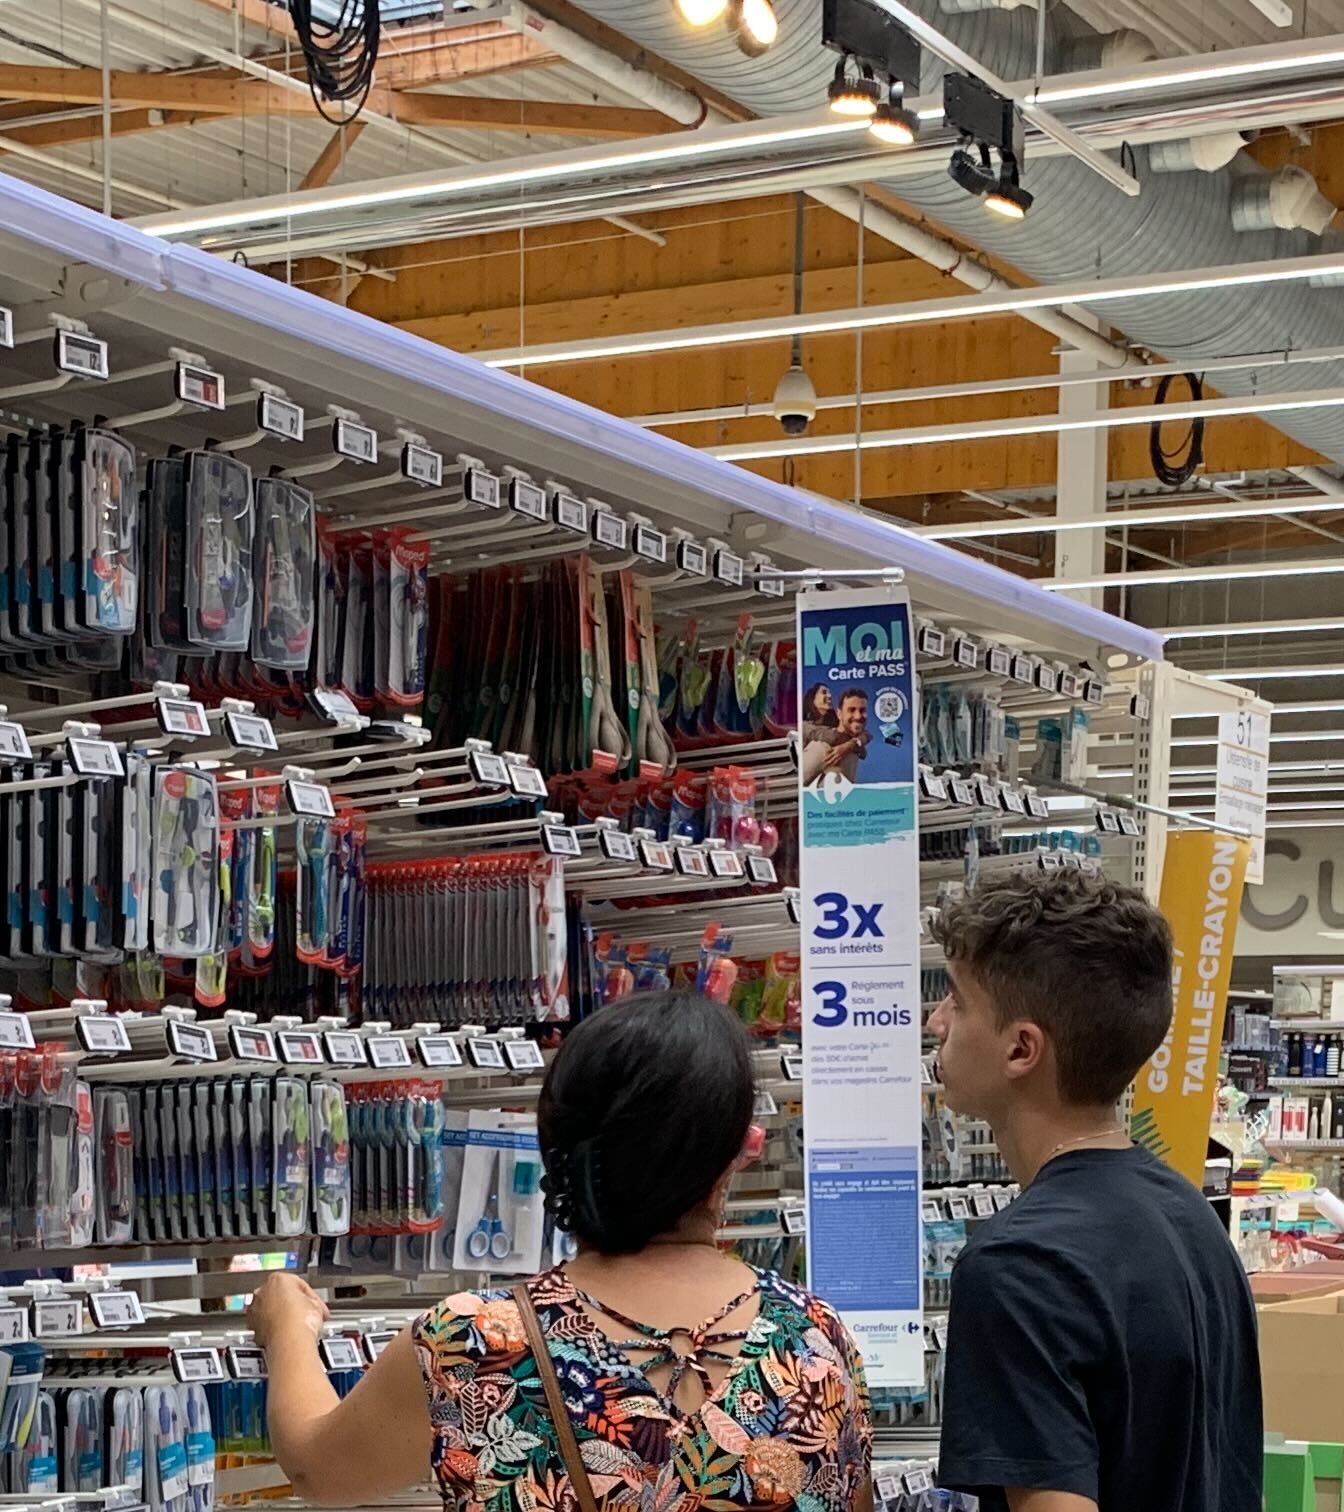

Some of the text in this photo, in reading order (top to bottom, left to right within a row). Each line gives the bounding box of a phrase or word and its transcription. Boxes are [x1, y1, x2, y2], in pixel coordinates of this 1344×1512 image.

[803, 620, 904, 667] MOI
[855, 645, 904, 662] et ma
[828, 664, 905, 680] Carte PASS
[812, 891, 885, 940] 3x
[809, 944, 837, 955] sans
[1181, 840, 1239, 1097] TAILLE-CRAYON
[812, 980, 848, 1028] 3
[853, 1003, 912, 1027] mois
[853, 1322, 898, 1333] Carrefour
